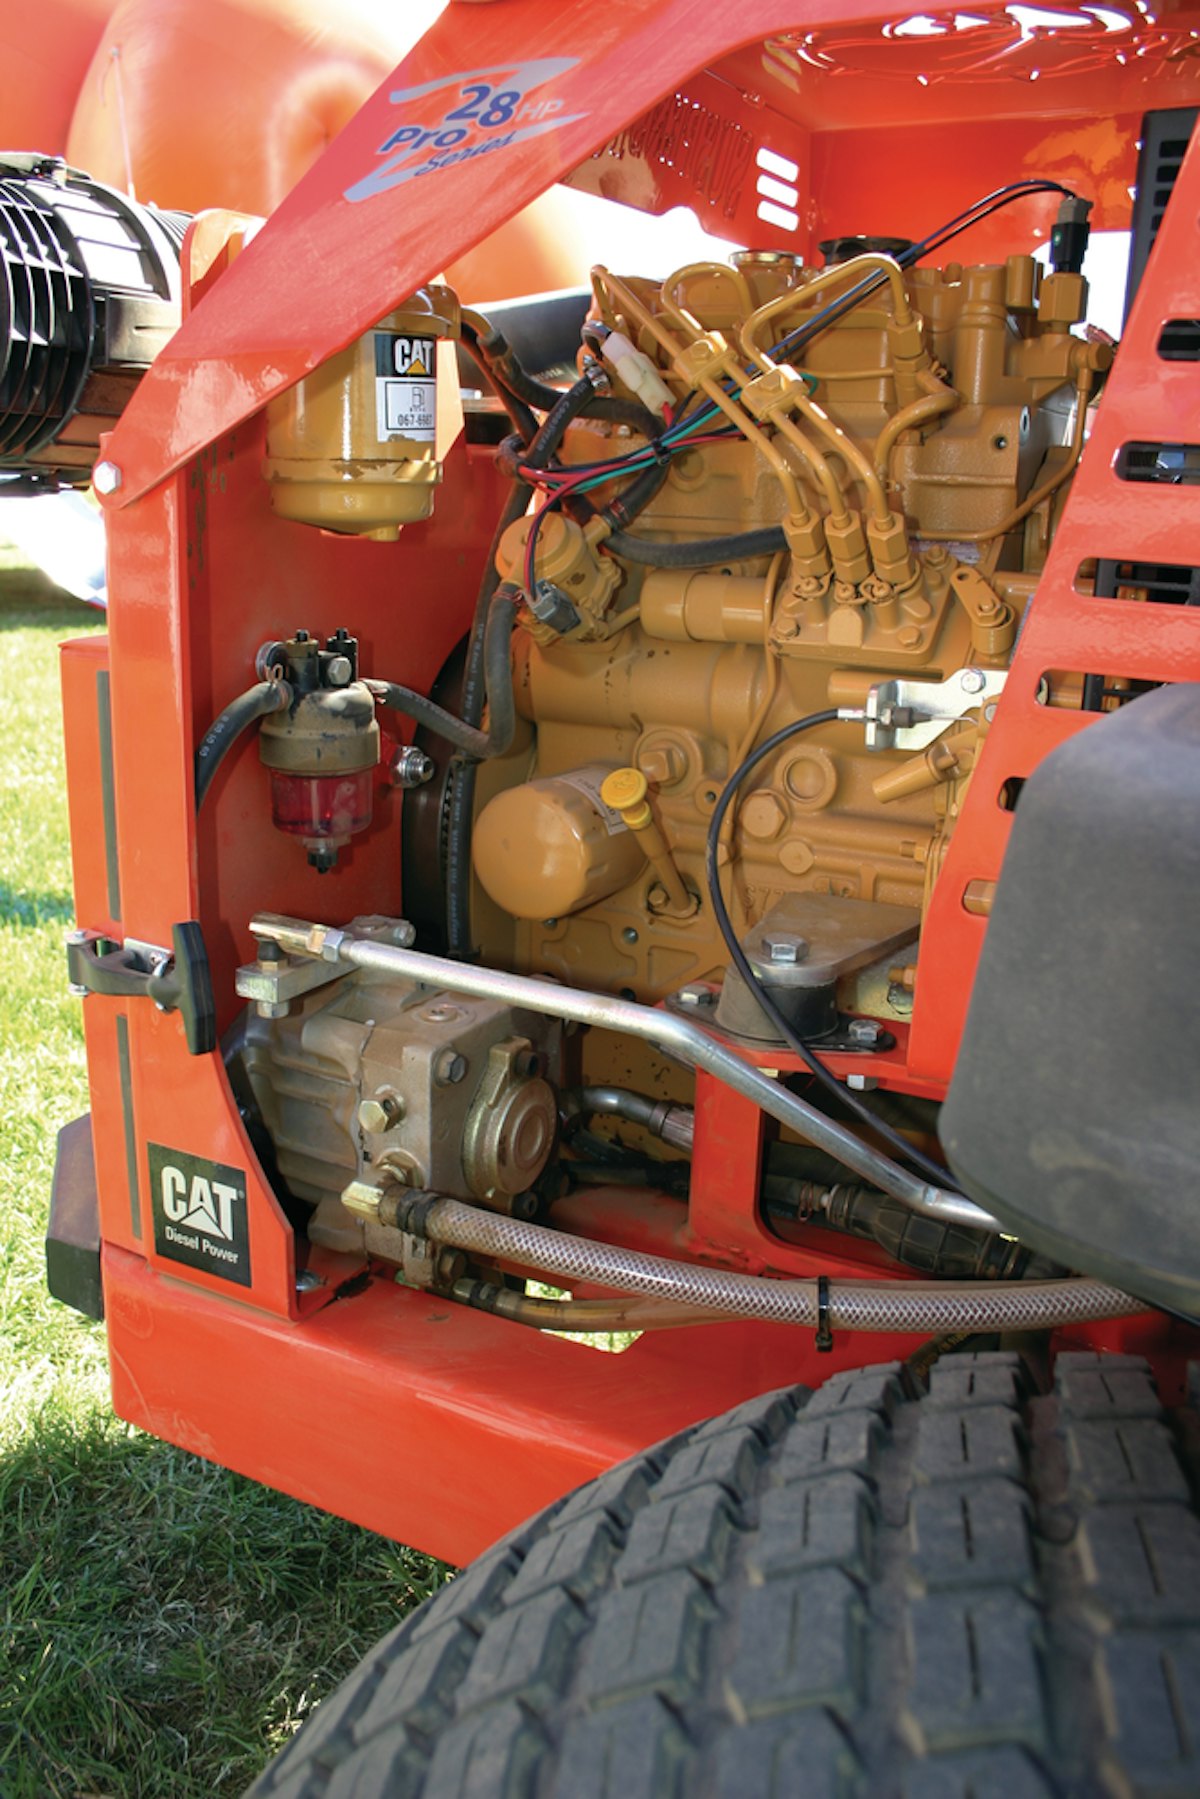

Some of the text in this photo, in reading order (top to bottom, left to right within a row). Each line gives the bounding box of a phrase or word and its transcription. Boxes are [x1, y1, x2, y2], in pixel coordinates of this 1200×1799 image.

[445, 84, 565, 128] 28 HP
[377, 126, 468, 153] Pro
[414, 130, 516, 177] Series
[394, 338, 434, 375] CAT
[161, 1165, 238, 1241] CAT
[165, 1226, 239, 1264] Diesel Power
